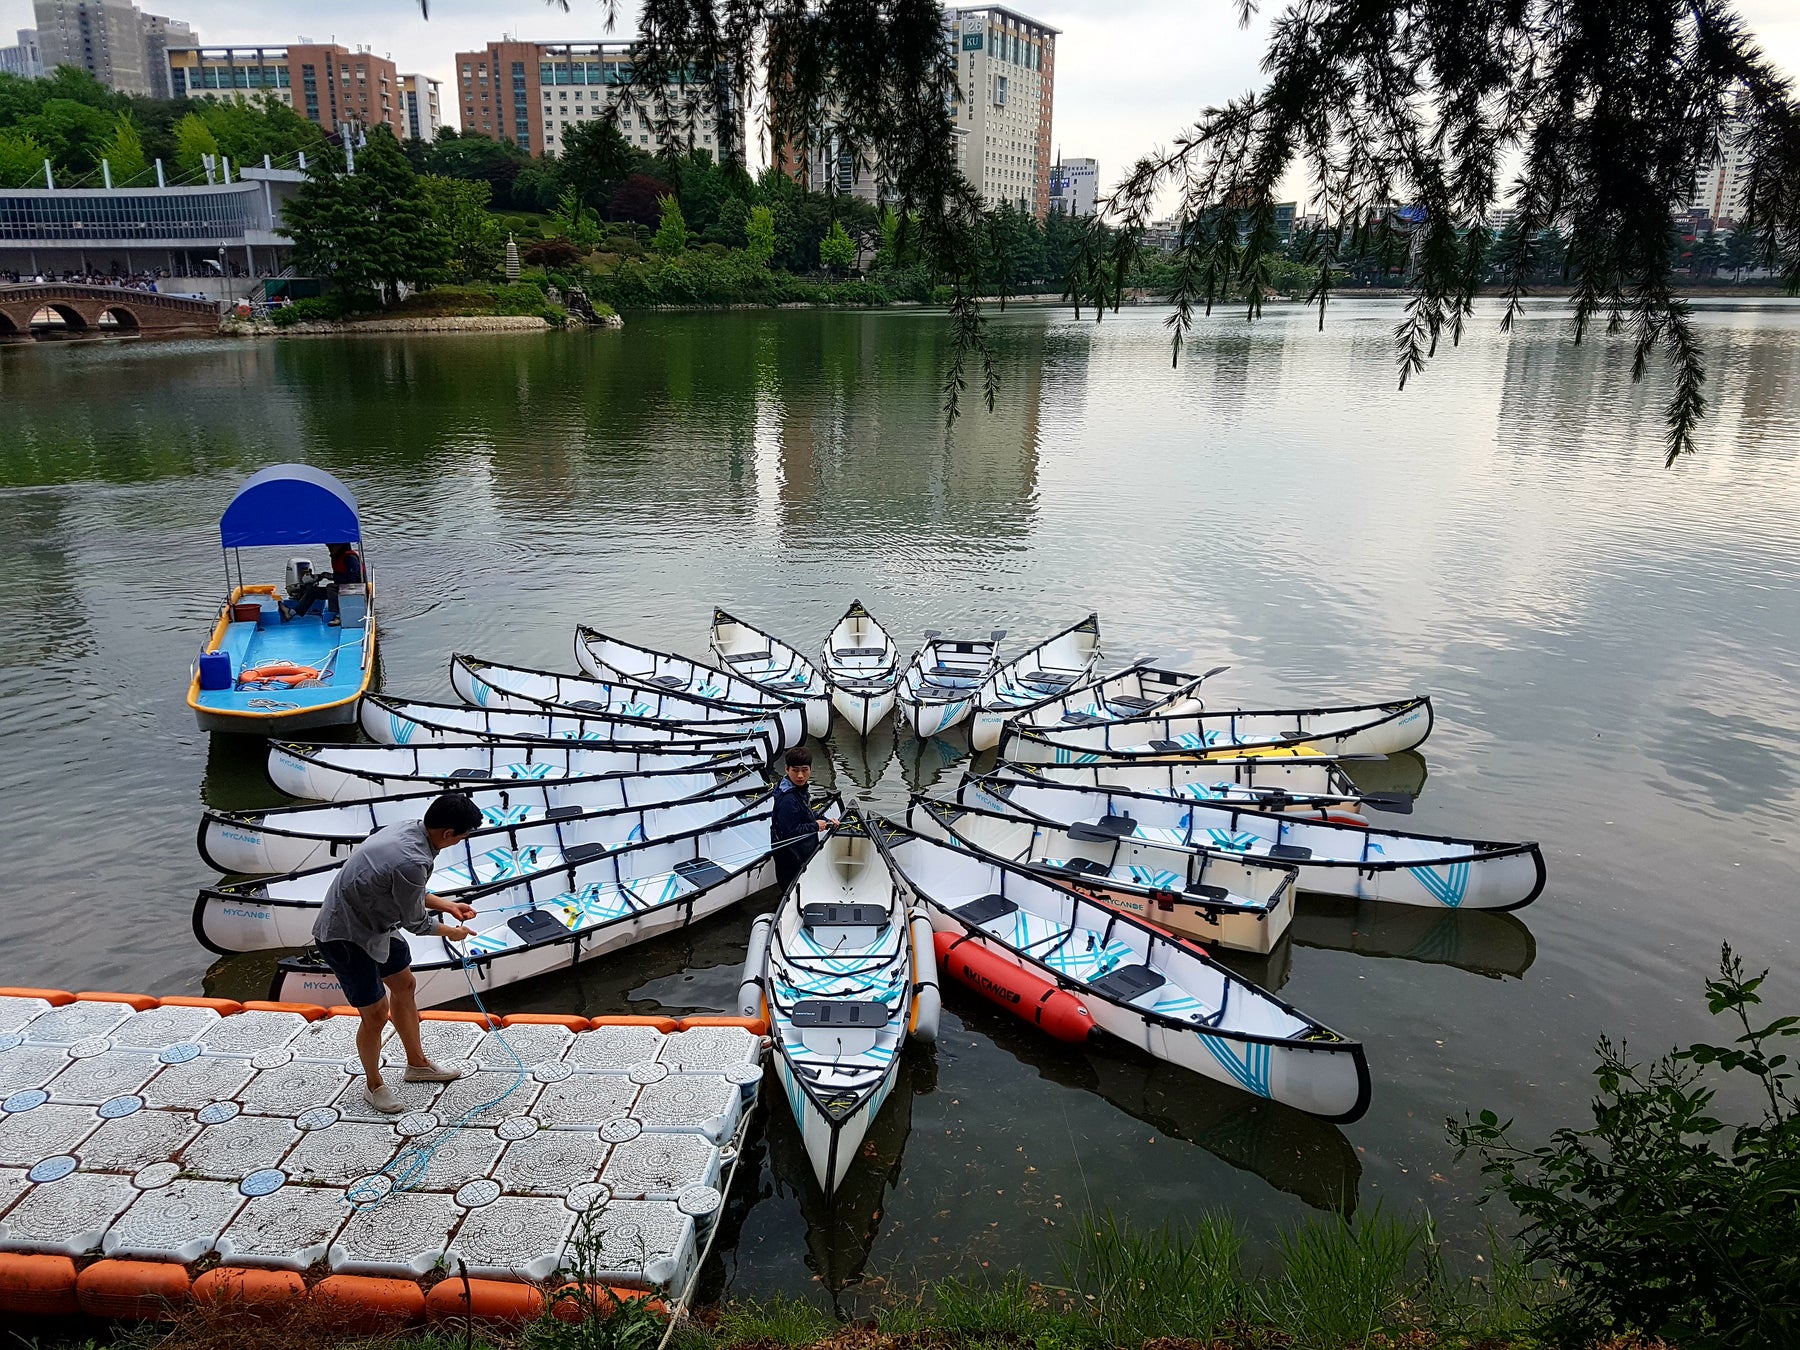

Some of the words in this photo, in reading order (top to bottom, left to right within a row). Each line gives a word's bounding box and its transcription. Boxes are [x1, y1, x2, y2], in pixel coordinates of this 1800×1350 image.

[968, 20, 983, 32] 26
[966, 37, 979, 47] KU
[976, 792, 1004, 812] MYCANOE
[222, 831, 261, 845] MYCANOE
[1103, 899, 1144, 911] MYCANOE
[223, 908, 271, 919] MYCANOE
[304, 981, 342, 990] MYCAN
